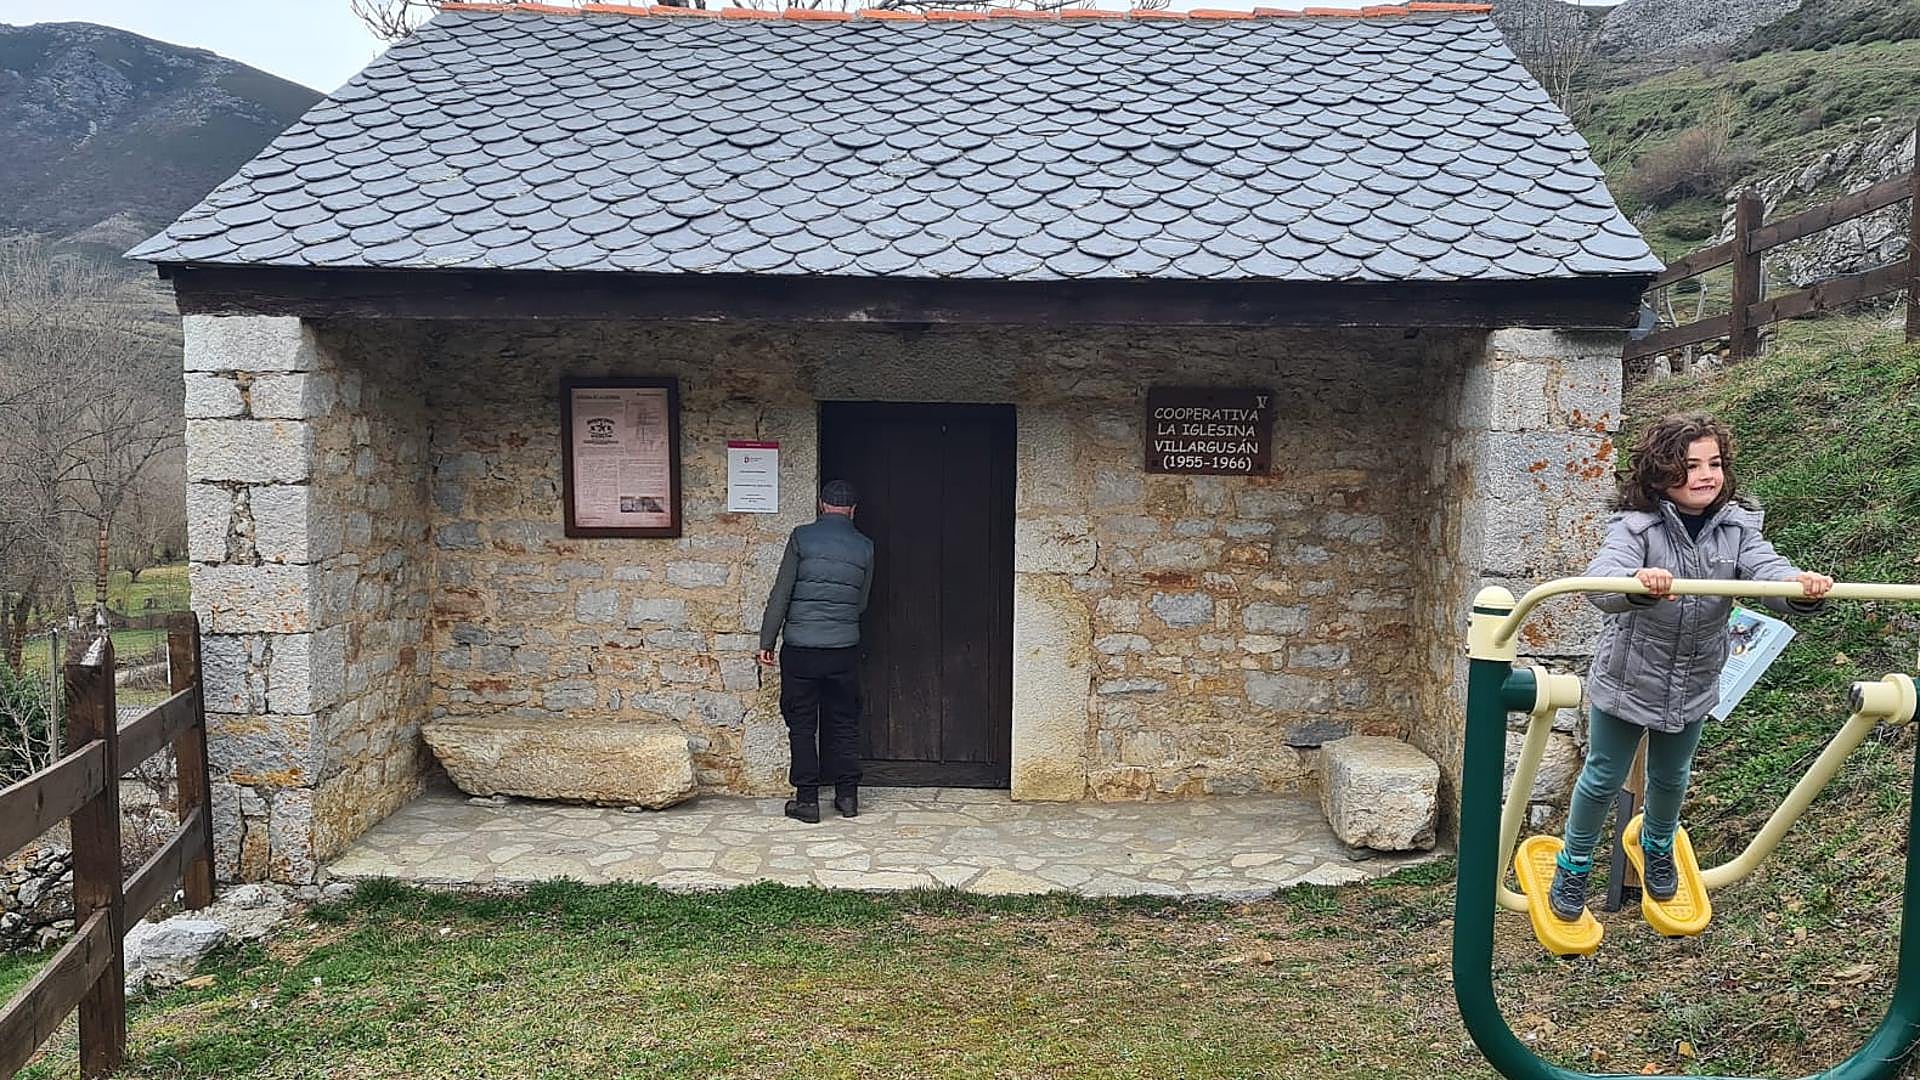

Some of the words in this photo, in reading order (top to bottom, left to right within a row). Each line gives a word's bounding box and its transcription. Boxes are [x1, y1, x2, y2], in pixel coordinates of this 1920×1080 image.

[1154, 408, 1259, 421] COOPERATIVA
[1158, 423, 1176, 435] LA
[1182, 424, 1255, 437] IGLESINA
[1154, 439, 1259, 454] VILLARGUSÁN
[1163, 456, 1252, 472] (1955-1966)
